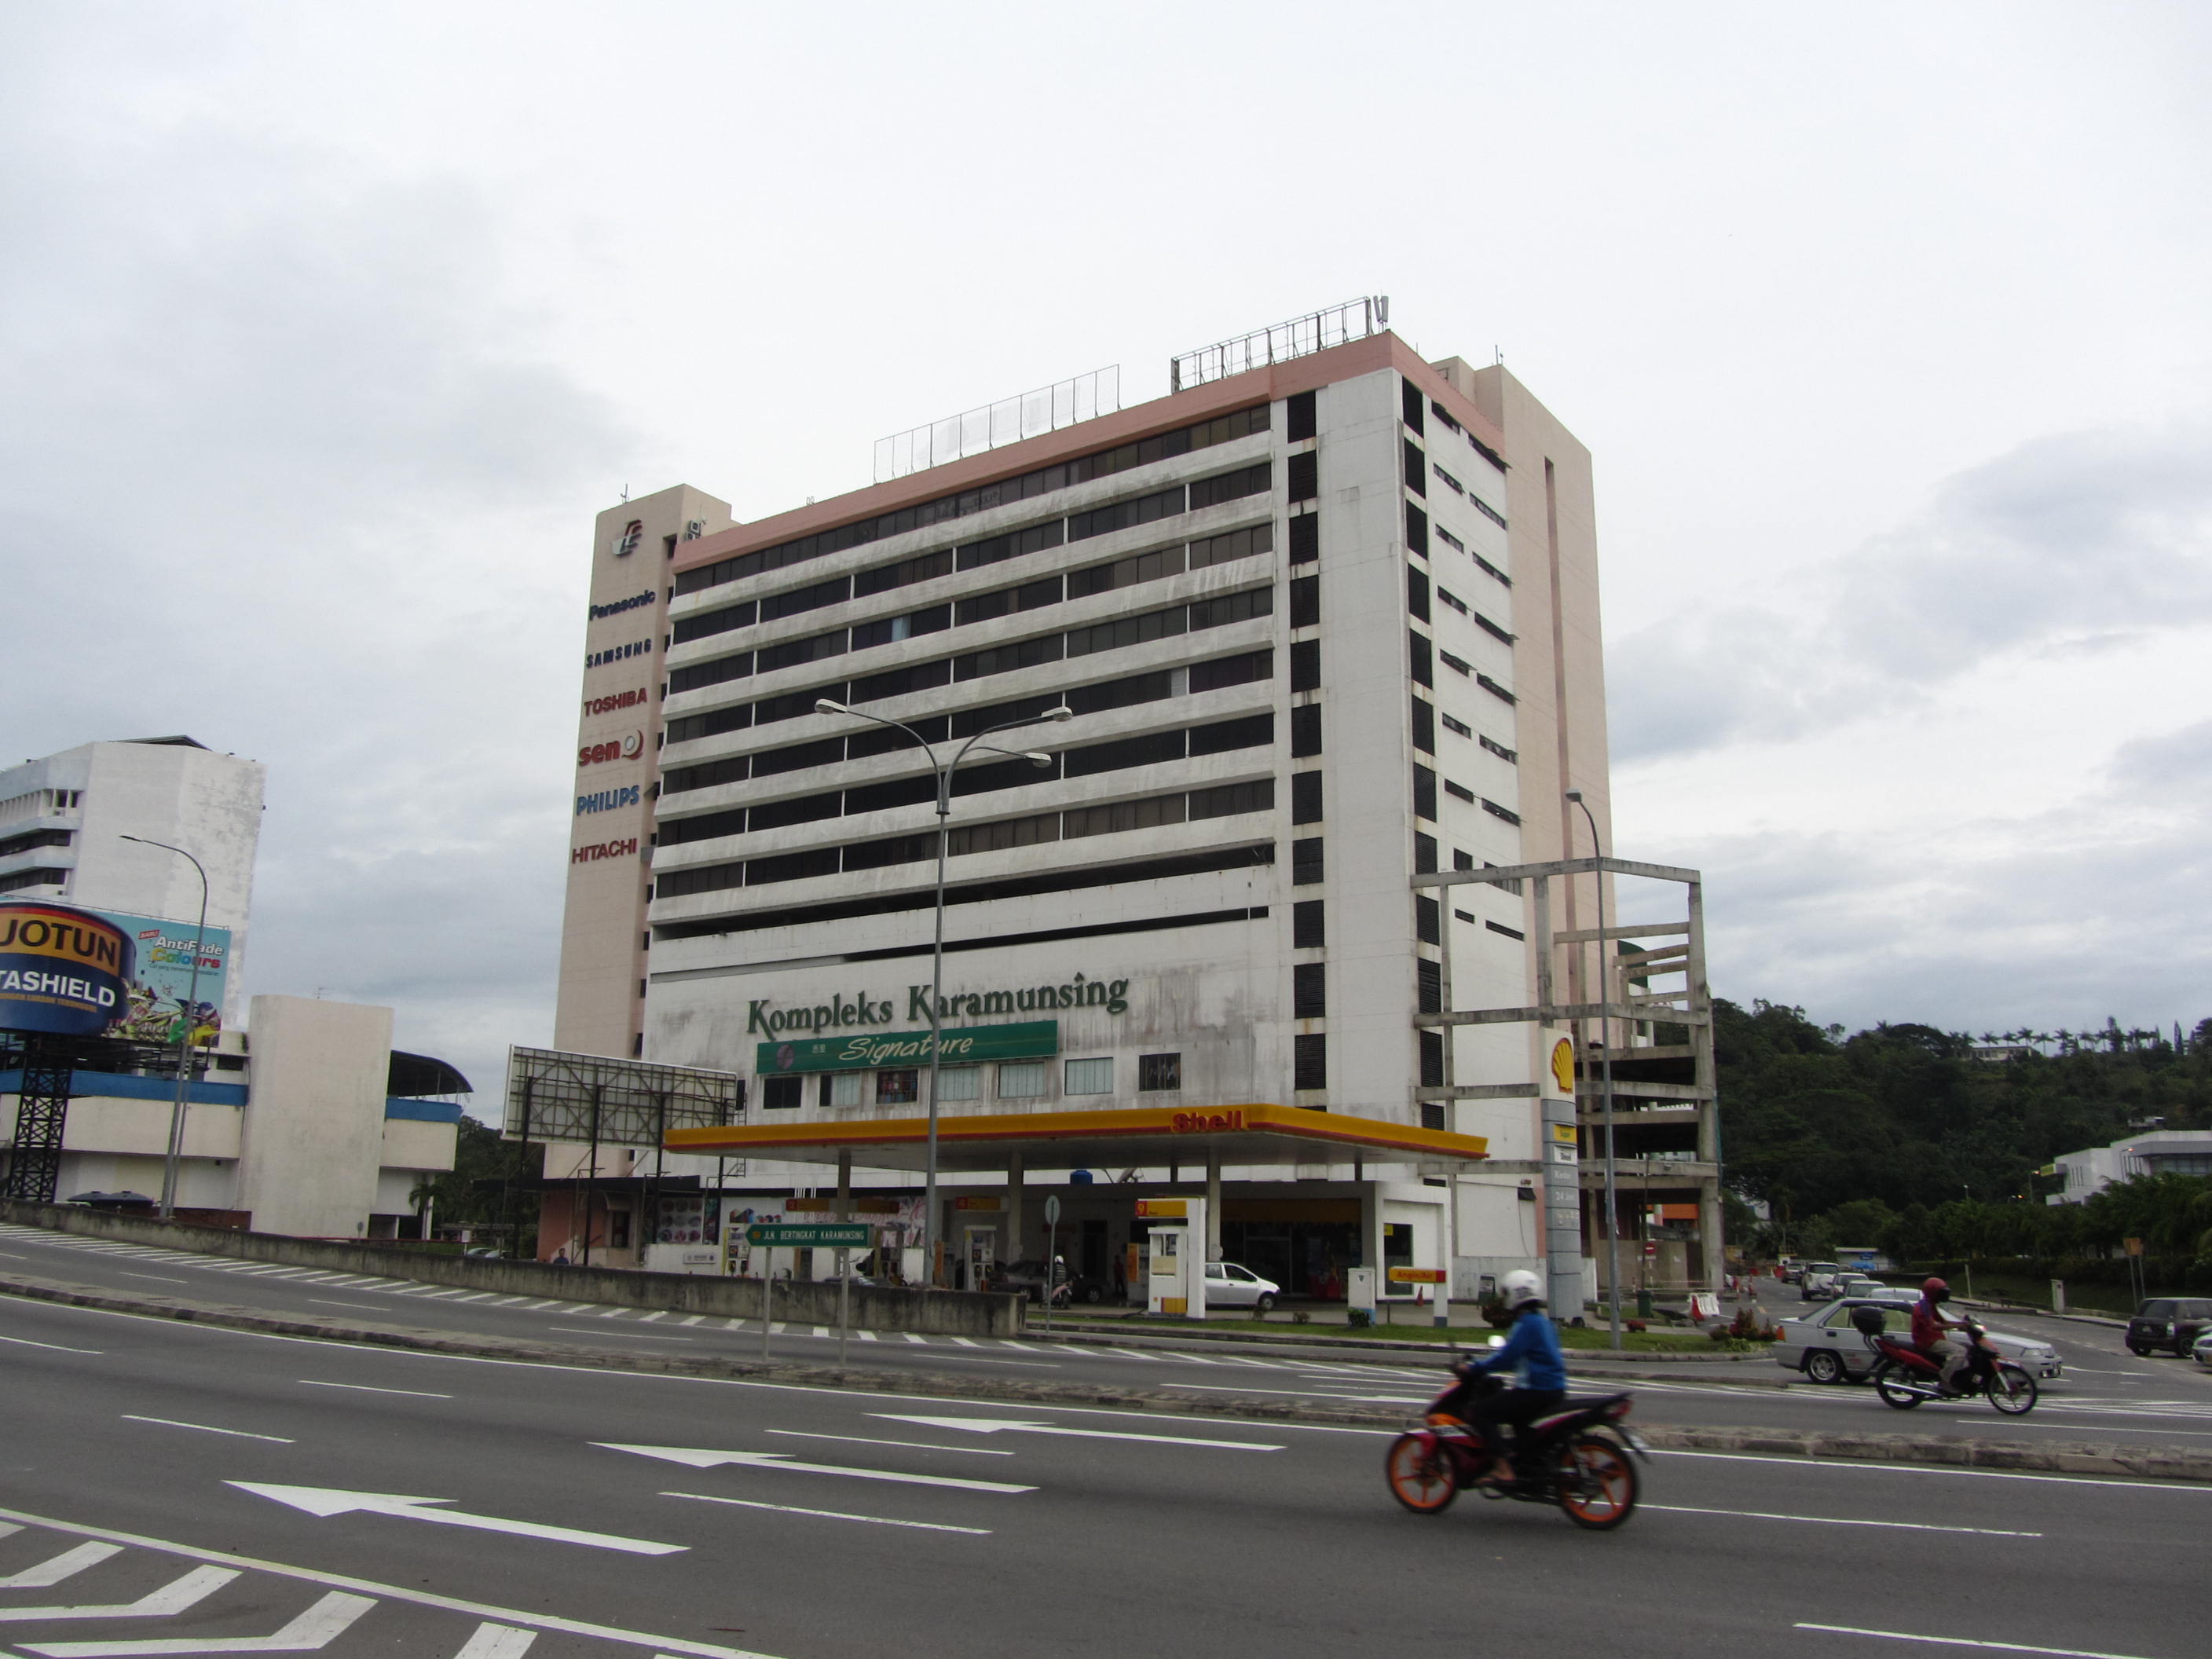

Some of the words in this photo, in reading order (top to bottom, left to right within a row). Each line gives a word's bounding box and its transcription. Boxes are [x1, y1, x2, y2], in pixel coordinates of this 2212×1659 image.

[589, 589, 655, 621] Panasonic
[586, 638, 651, 668] SAMSUNG
[584, 687, 647, 717] TOSHIBA
[577, 785, 639, 815] PHILIPS
[572, 837, 637, 864] HITACHI
[0, 919, 116, 968] JOTUN
[747, 990, 893, 1042] Kompleks
[906, 971, 1129, 1027] Karamunsing
[838, 1034, 974, 1065] Signature
[1173, 1110, 1244, 1132] Shell
[764, 1231, 775, 1240] JLN
